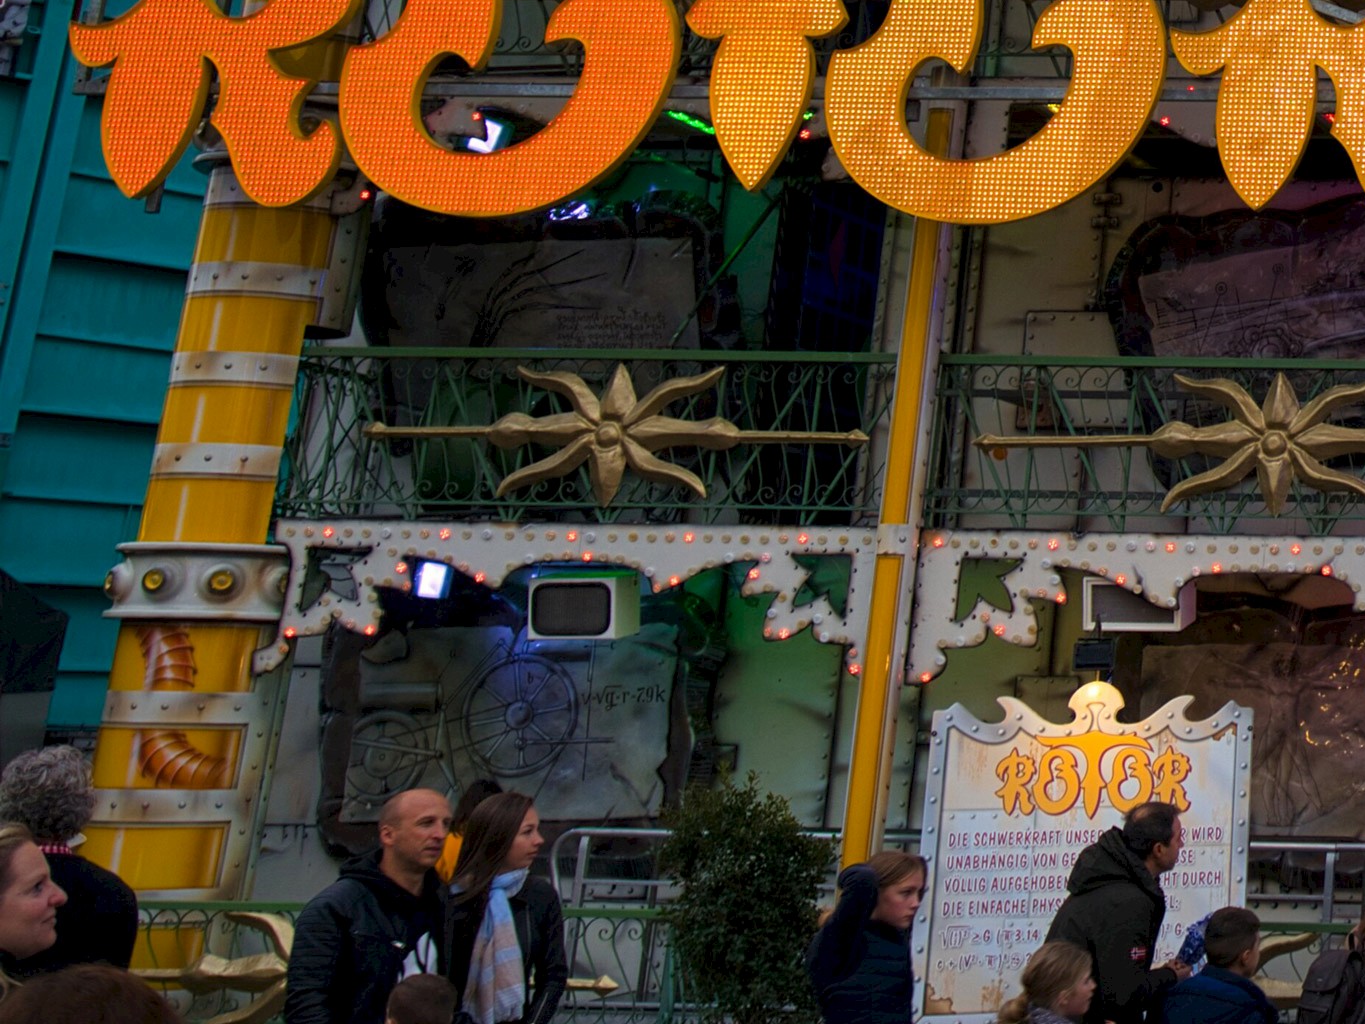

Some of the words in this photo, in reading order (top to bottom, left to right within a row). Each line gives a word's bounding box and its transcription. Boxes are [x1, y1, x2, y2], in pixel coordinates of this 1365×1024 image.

[995, 730, 1192, 820] ROTOR
[949, 833, 968, 847] DIE
[973, 830, 1061, 847] SCHWERKRAFT
[1192, 827, 1222, 841] WIRD
[947, 851, 1027, 870] UNABHÄNGIG
[1033, 853, 1057, 867] VON
[945, 875, 986, 893] VÖLLIG
[1182, 871, 1222, 886] DURCH
[943, 901, 962, 916] DIE
[968, 899, 1026, 915] EINFACHE
